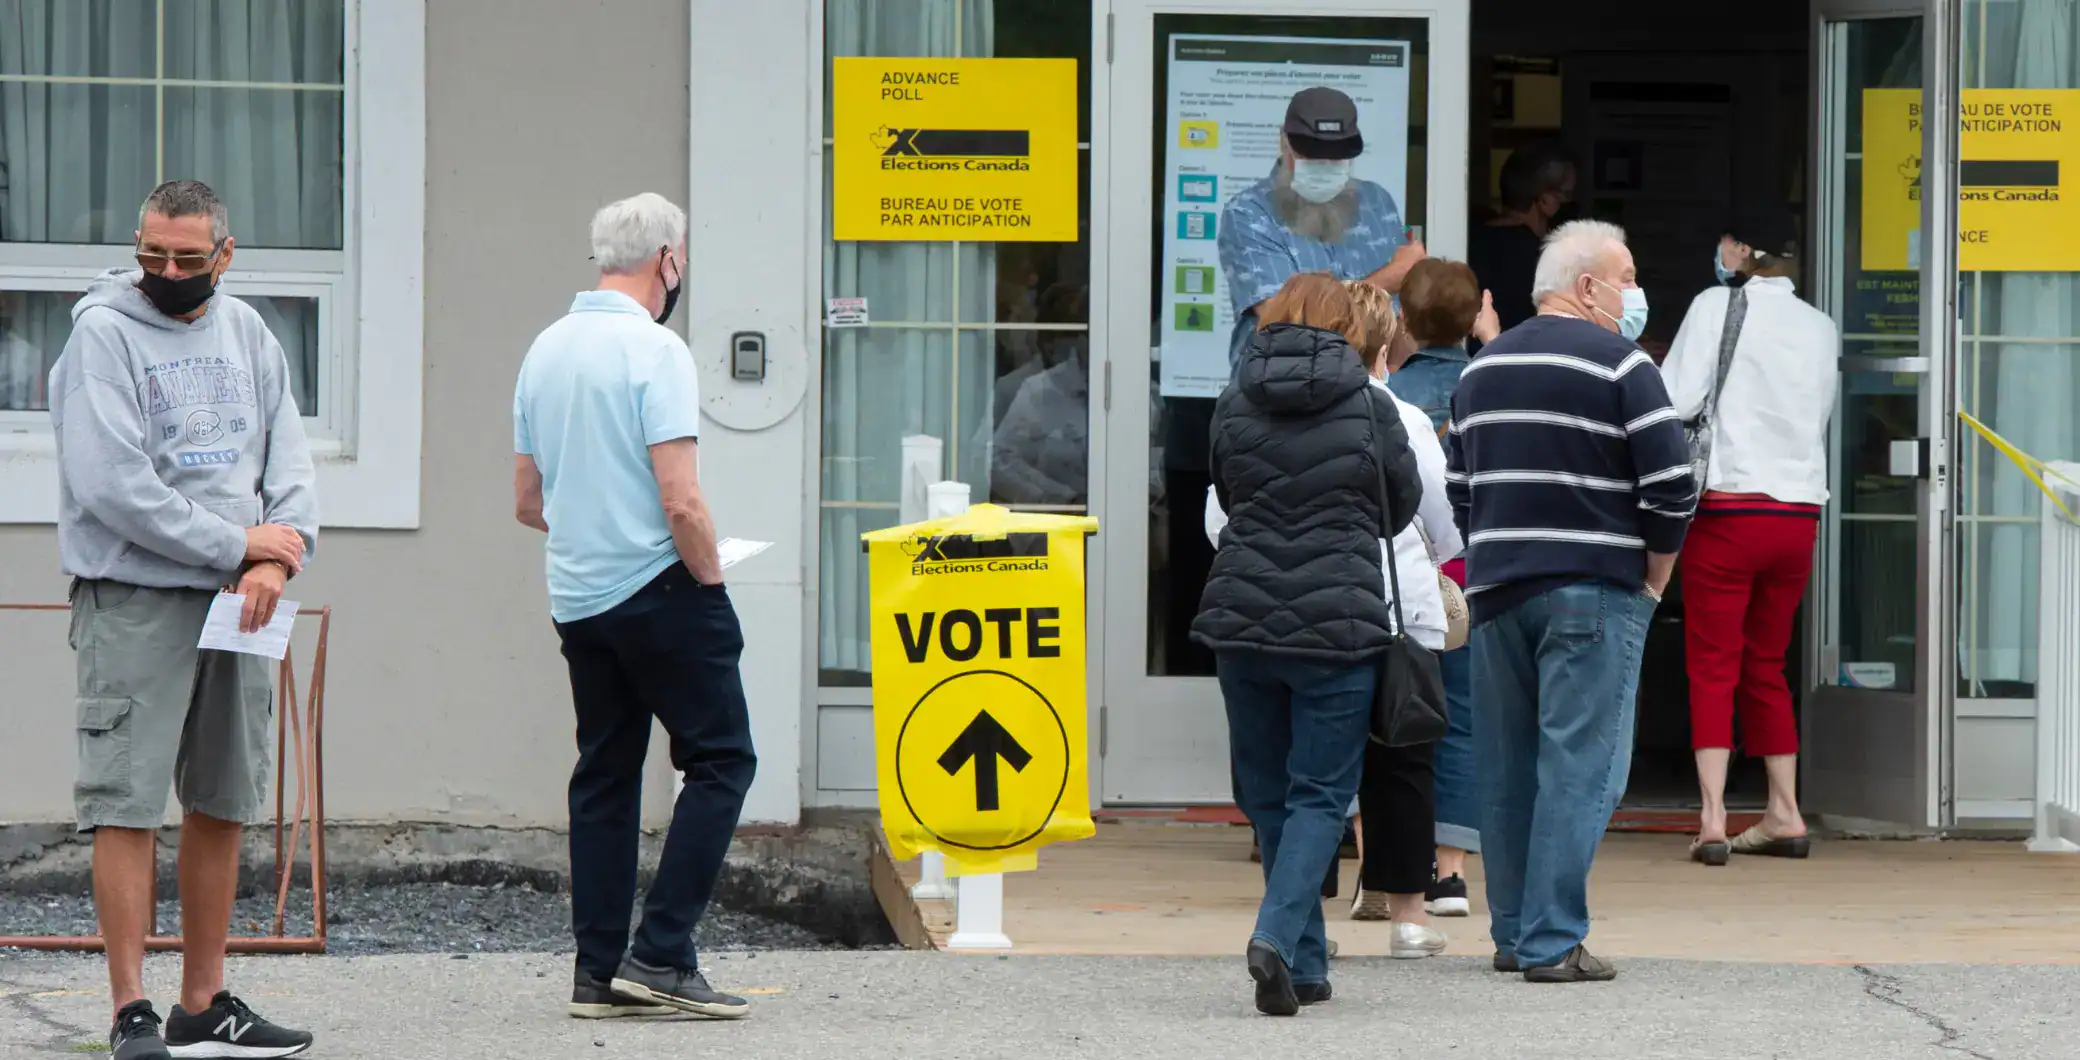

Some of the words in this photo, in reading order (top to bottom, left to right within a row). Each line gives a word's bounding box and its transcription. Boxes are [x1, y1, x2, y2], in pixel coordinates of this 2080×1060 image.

[881, 72, 960, 85] ADVANCE
[881, 88, 924, 101] POLL
[1984, 104, 2005, 116] DE
[2009, 104, 2053, 116] VOTE
[1960, 120, 2061, 132] NTICIPATION
[881, 157, 960, 171] Elections
[964, 158, 1030, 171] Canada
[1993, 188, 2060, 202] Canada
[881, 198, 948, 211] BUREAU
[953, 198, 975, 211] DE
[979, 198, 1023, 211] VOTE
[881, 214, 914, 227] PAR
[918, 214, 1031, 228] ANTICIPATION
[143, 356, 235, 376] MONTREAL
[162, 423, 178, 440] 19
[229, 416, 247, 433] 09
[184, 450, 235, 466] HOCKEY
[911, 563, 984, 576] Elections
[987, 559, 1049, 572] Canada
[893, 606, 1061, 664] VOTE
